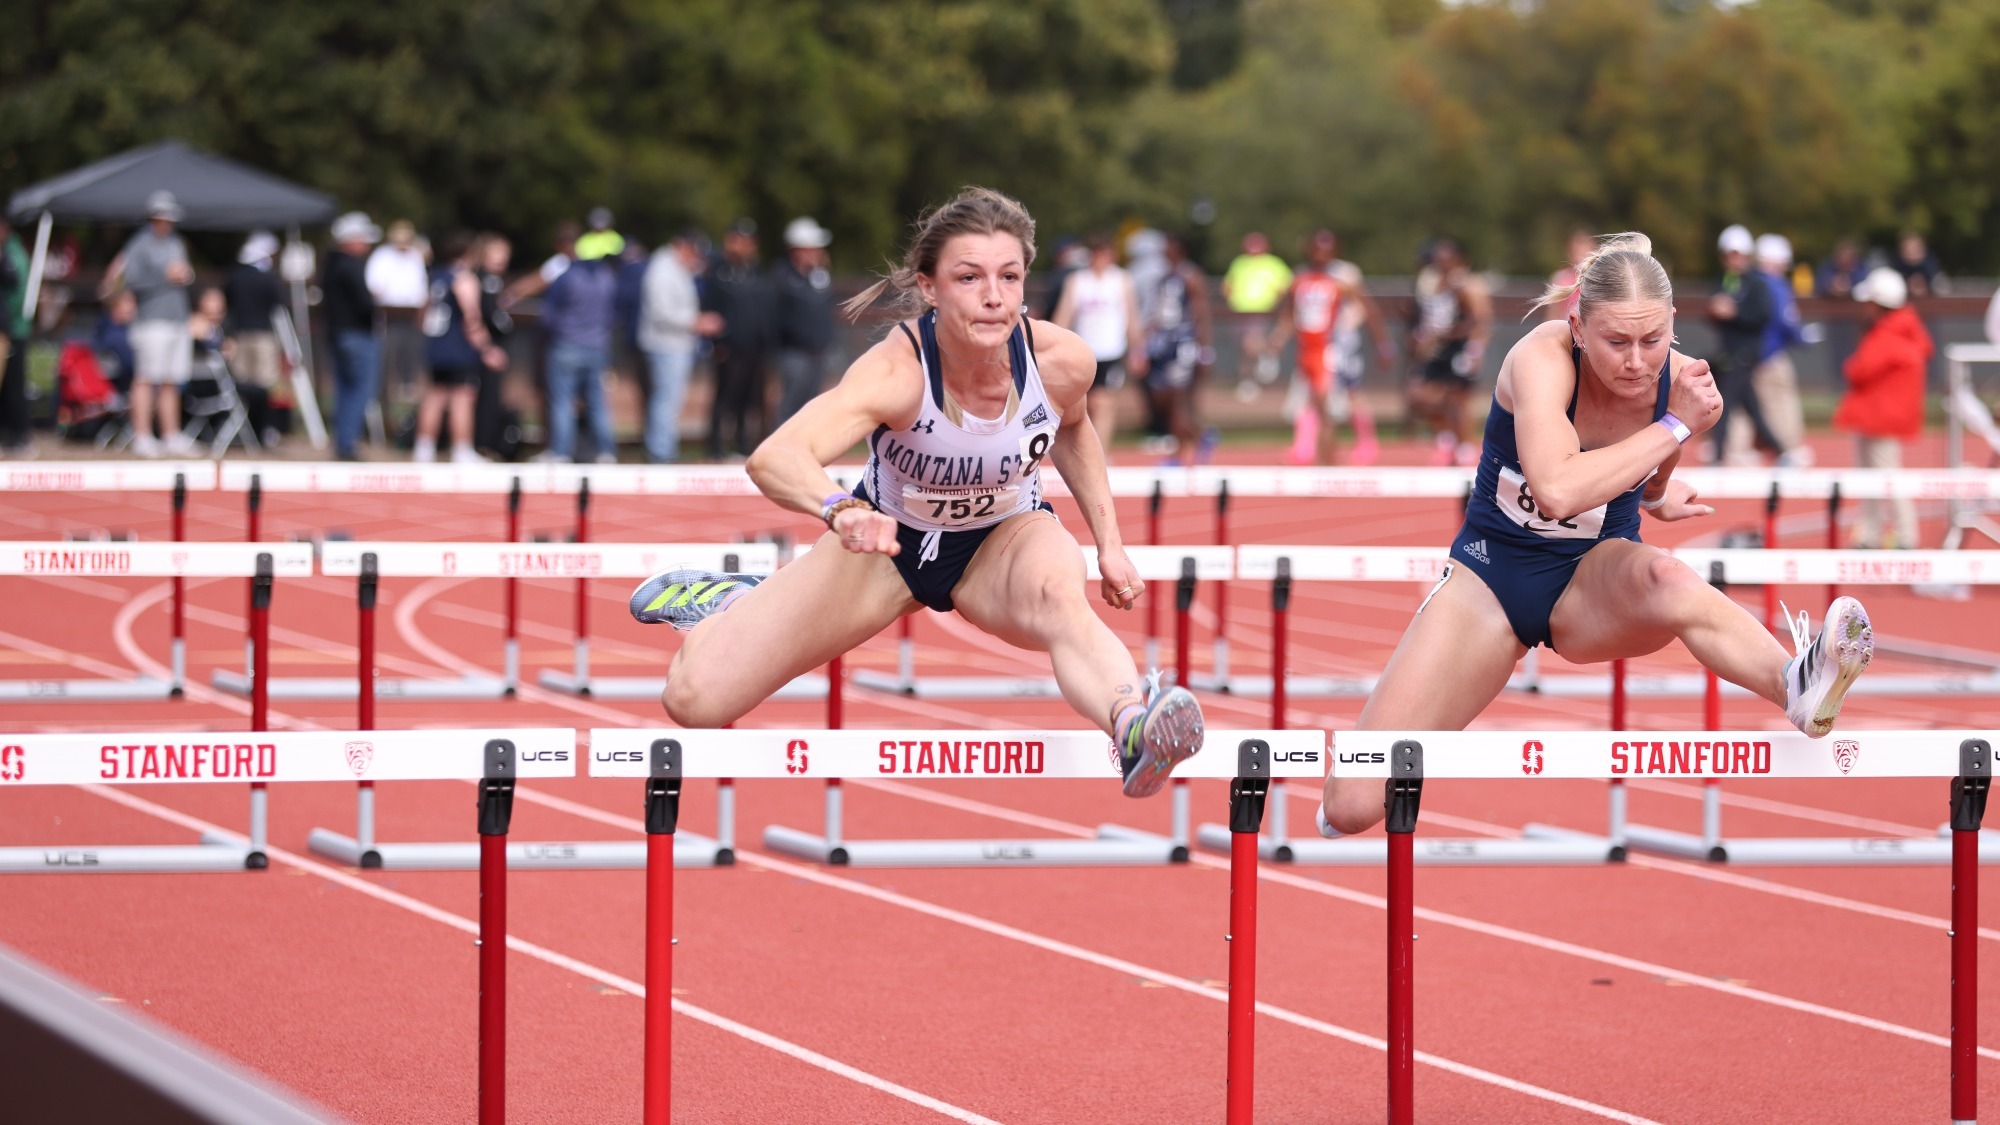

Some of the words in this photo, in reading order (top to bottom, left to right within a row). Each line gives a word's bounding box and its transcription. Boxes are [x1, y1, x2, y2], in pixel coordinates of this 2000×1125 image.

[1032, 405, 1045, 422] SKY
[884, 439, 983, 486] MONTANA
[926, 494, 996, 520] 752
[23, 551, 131, 574] STANFORD
[1463, 543, 1491, 565] adidas
[100, 744, 277, 779] STANFORD
[522, 751, 569, 762] UCS
[596, 751, 644, 762] UCS
[878, 740, 1045, 774] STANFORD
[1273, 751, 1319, 762] UCS
[1339, 752, 1385, 764] UCS
[1611, 741, 1771, 774] STANFORD
[1841, 758, 1852, 768] 12
[44, 851, 99, 867] UCS
